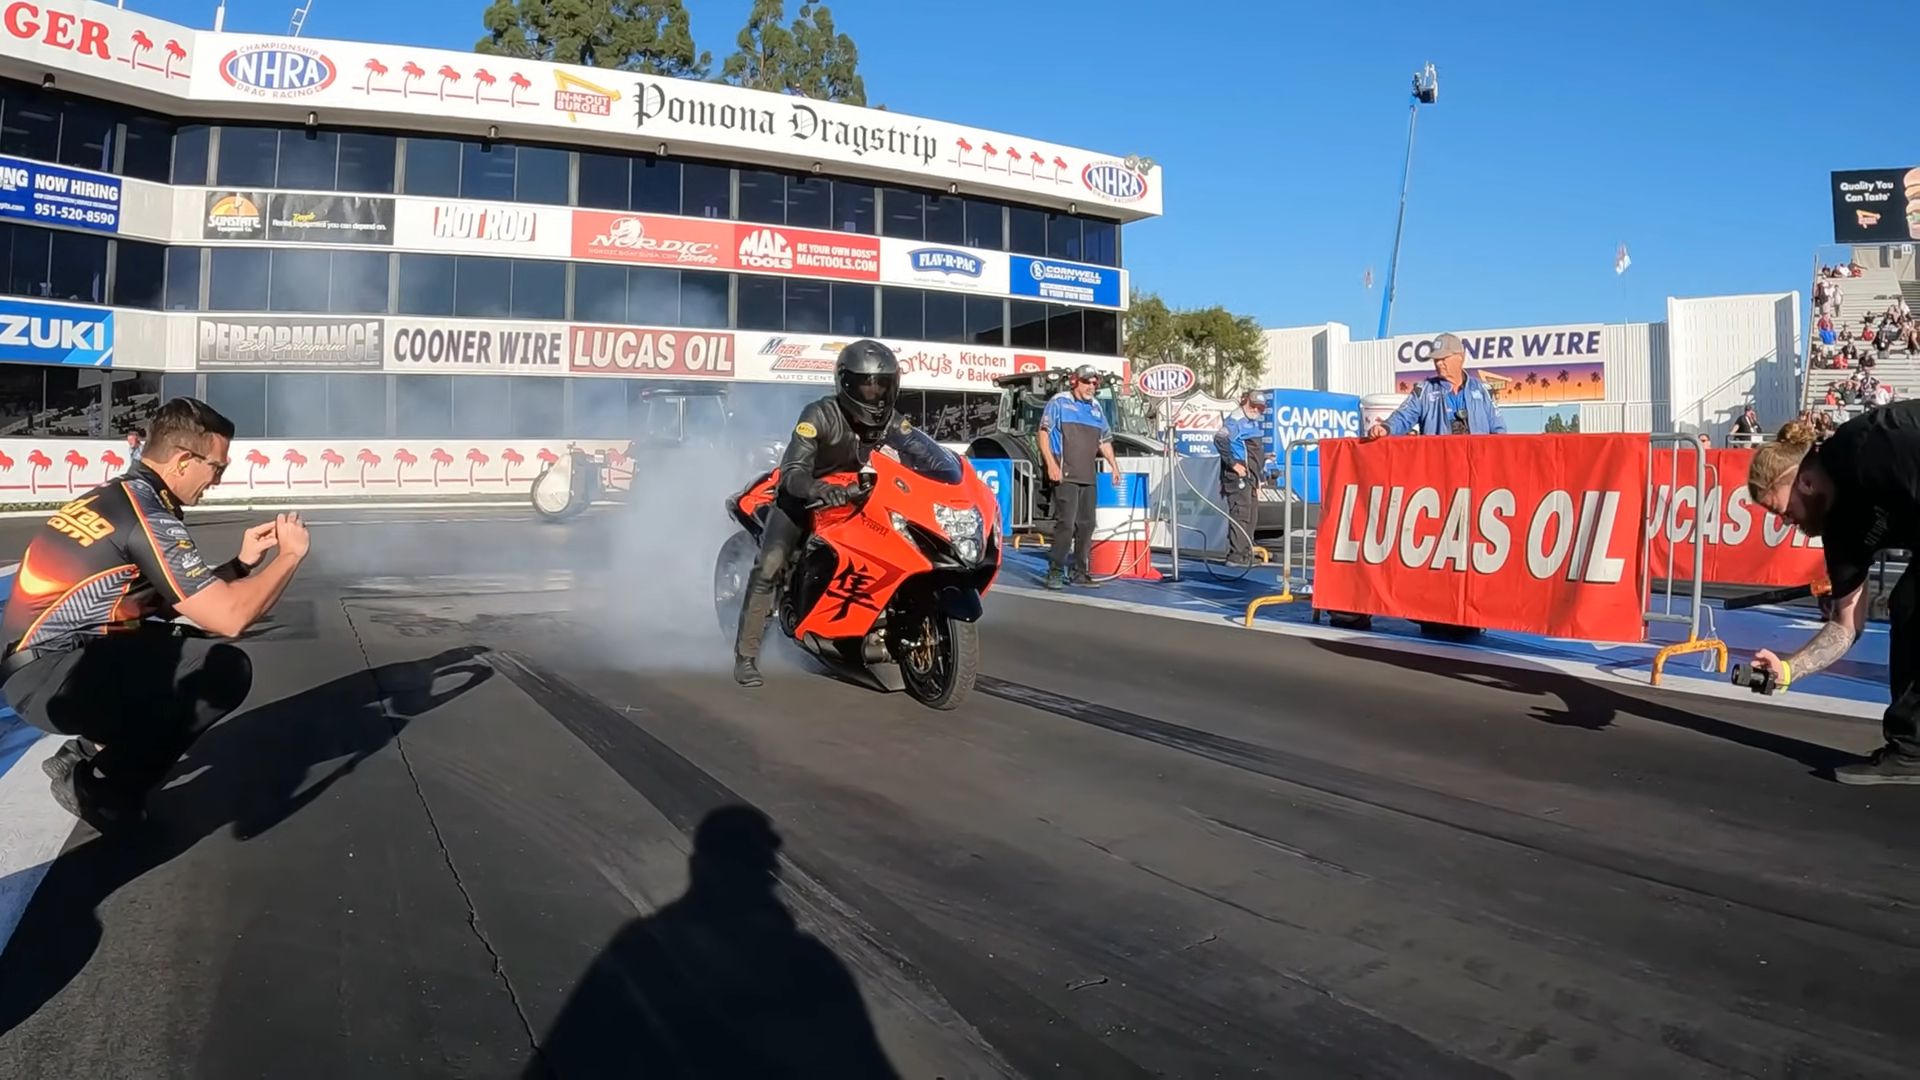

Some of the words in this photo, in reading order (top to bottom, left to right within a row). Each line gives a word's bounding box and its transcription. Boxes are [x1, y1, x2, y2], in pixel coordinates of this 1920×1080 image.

[4, 1, 112, 60] GER
[239, 42, 320, 56] CHAMPIONSHIP
[236, 51, 320, 88] NHRA
[237, 83, 266, 97] DRAG
[272, 87, 315, 99] RACING
[632, 81, 777, 135] Pomona
[788, 103, 938, 166] Dragstrip
[34, 173, 69, 193] NOW
[70, 179, 119, 201] HIRING
[1091, 166, 1140, 197] NHRA
[1840, 181, 1875, 191] Quality
[1876, 181, 1894, 189] You
[1845, 193, 1863, 202] Can
[34, 203, 115, 226] 951-520-8590
[434, 205, 482, 239] HOT
[484, 208, 537, 242] ROD
[589, 234, 712, 255] NORDIC
[739, 229, 793, 259] MAC
[797, 242, 809, 253] BE
[809, 244, 831, 255] YOUR
[831, 248, 850, 257] OWN
[739, 255, 793, 270] TOOLS
[797, 253, 877, 272] MACTOOLS.COM
[1046, 265, 1101, 279] CORNWELL
[1046, 272, 1077, 282] QUALITY
[0, 314, 105, 351] ZUKI
[200, 320, 379, 361] PERFORMANCE
[394, 327, 492, 364] COONER
[500, 331, 562, 365] WIRE
[574, 330, 676, 370] LUCAS
[684, 335, 732, 371] OIL
[1397, 335, 1514, 364] CONER
[1521, 330, 1601, 360] WIRE
[776, 373, 804, 381] AUTO
[897, 350, 953, 378] orky's
[960, 351, 1007, 368] Kitchen
[956, 368, 964, 380] &
[1147, 369, 1187, 391] NHRA
[1277, 406, 1359, 432] CAMPING
[1189, 444, 1211, 453] INC.
[1649, 485, 1752, 546] UCAS
[1331, 483, 1517, 574] LUCAS
[1525, 489, 1626, 584] OIL
[826, 556, 881, 623] 隼
